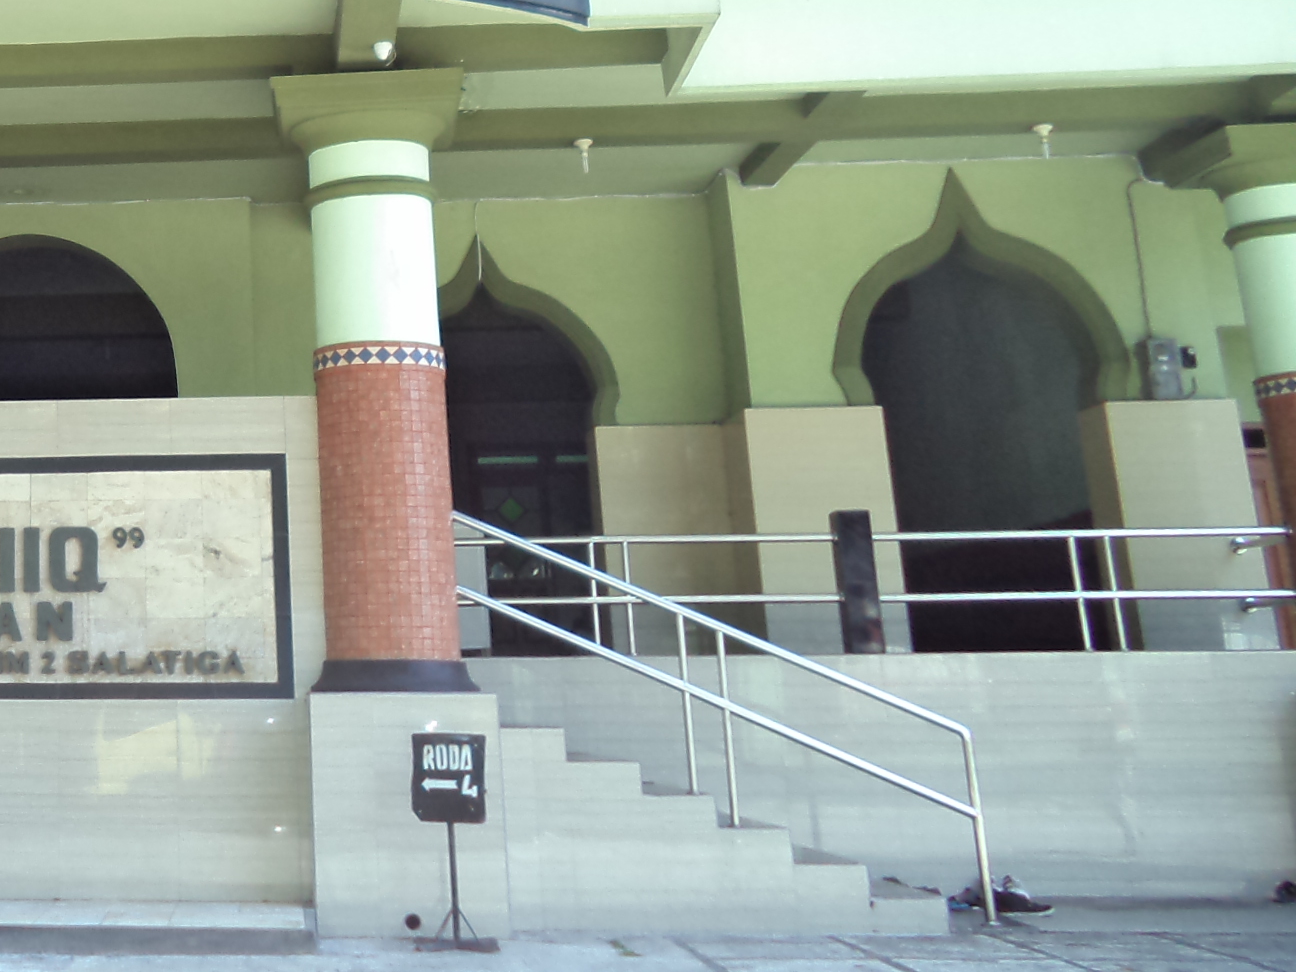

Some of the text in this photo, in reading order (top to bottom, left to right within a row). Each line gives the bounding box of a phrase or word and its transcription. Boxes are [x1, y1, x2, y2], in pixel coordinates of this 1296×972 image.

[41, 652, 57, 675] 2
[68, 650, 246, 675] SALATIGA
[422, 744, 473, 771] RODA
[461, 774, 478, 798] 4
